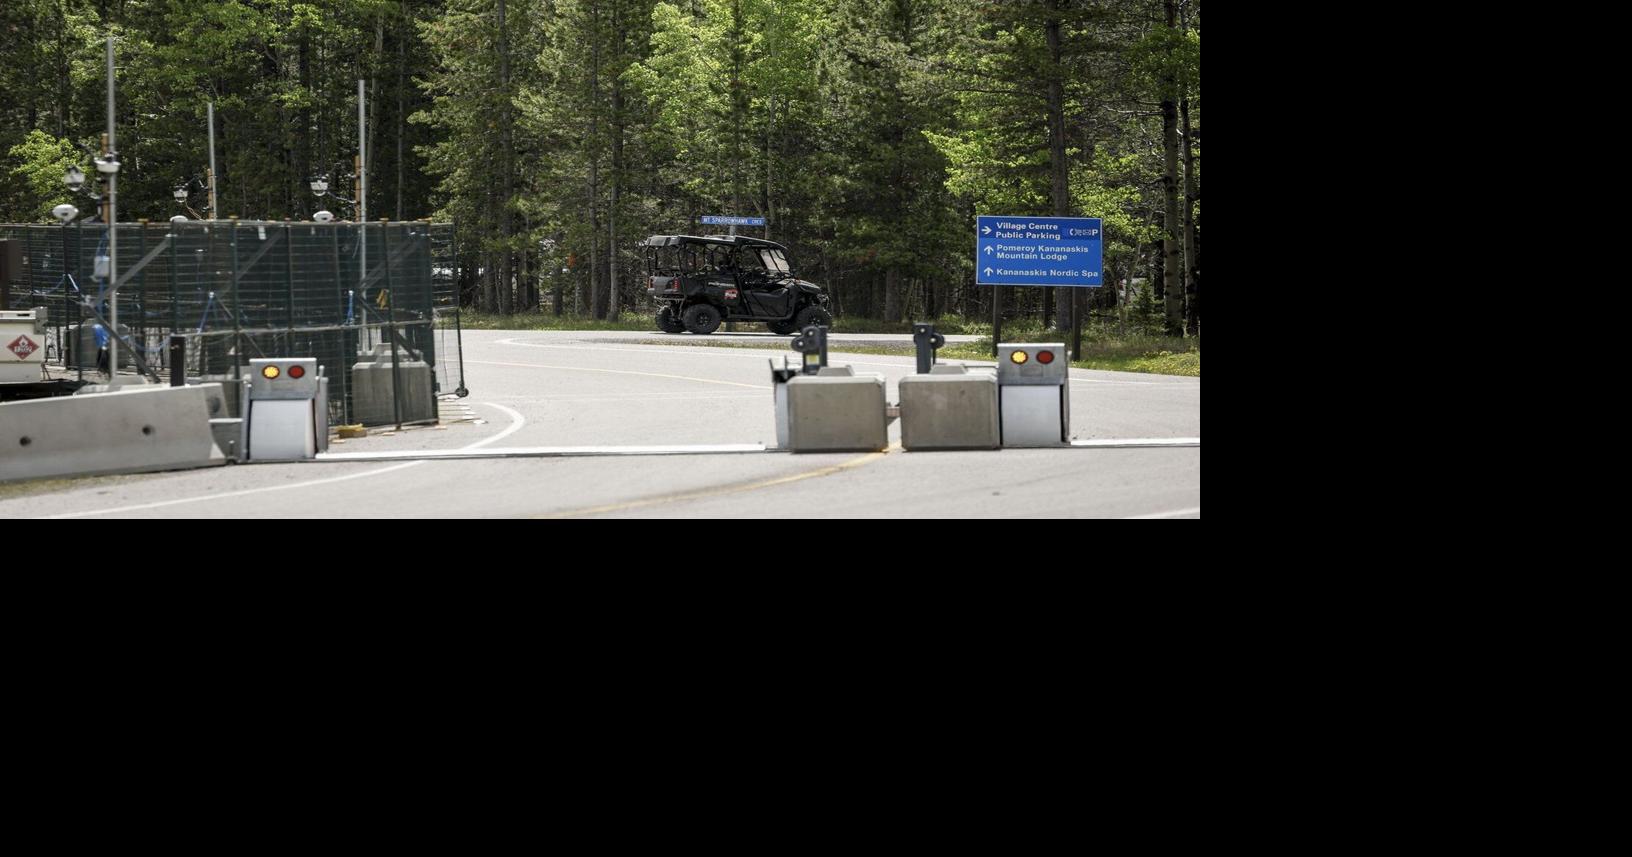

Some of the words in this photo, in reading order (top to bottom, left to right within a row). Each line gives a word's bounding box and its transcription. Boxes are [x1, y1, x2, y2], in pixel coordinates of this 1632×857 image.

[996, 222, 1026, 231] Village
[1028, 222, 1058, 230] Centre
[1026, 232, 1061, 240] Parking
[996, 244, 1035, 252] Pomeroy
[996, 252, 1038, 260] Mountain
[1081, 270, 1098, 278] Spa
